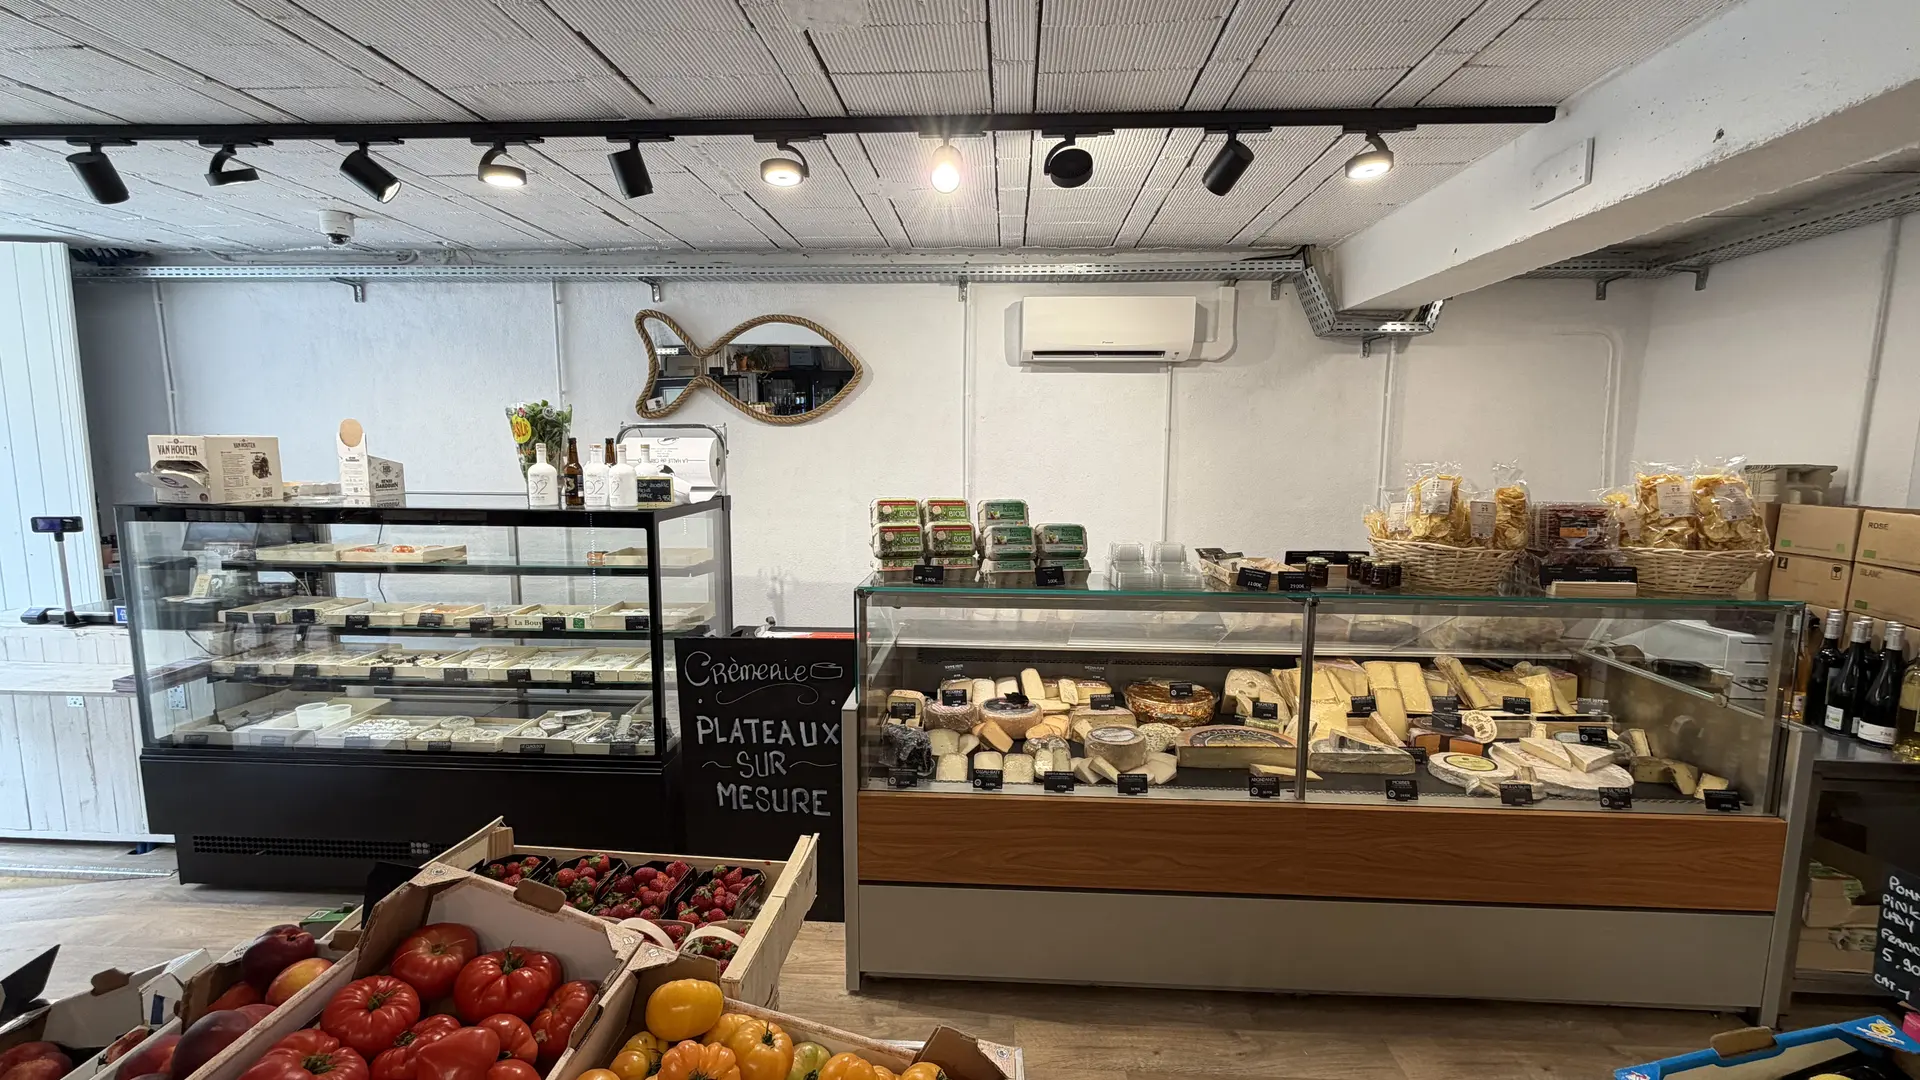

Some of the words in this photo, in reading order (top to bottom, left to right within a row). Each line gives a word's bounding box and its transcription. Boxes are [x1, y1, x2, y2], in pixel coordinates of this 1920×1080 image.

[157, 444, 170, 455] VAN
[171, 445, 198, 456] HOUTEN
[1868, 522, 1889, 530] ROSE
[524, 619, 542, 628] Bouy
[696, 715, 840, 747] PLATEAUX
[736, 751, 787, 778] SUR
[717, 781, 831, 817] MESURE
